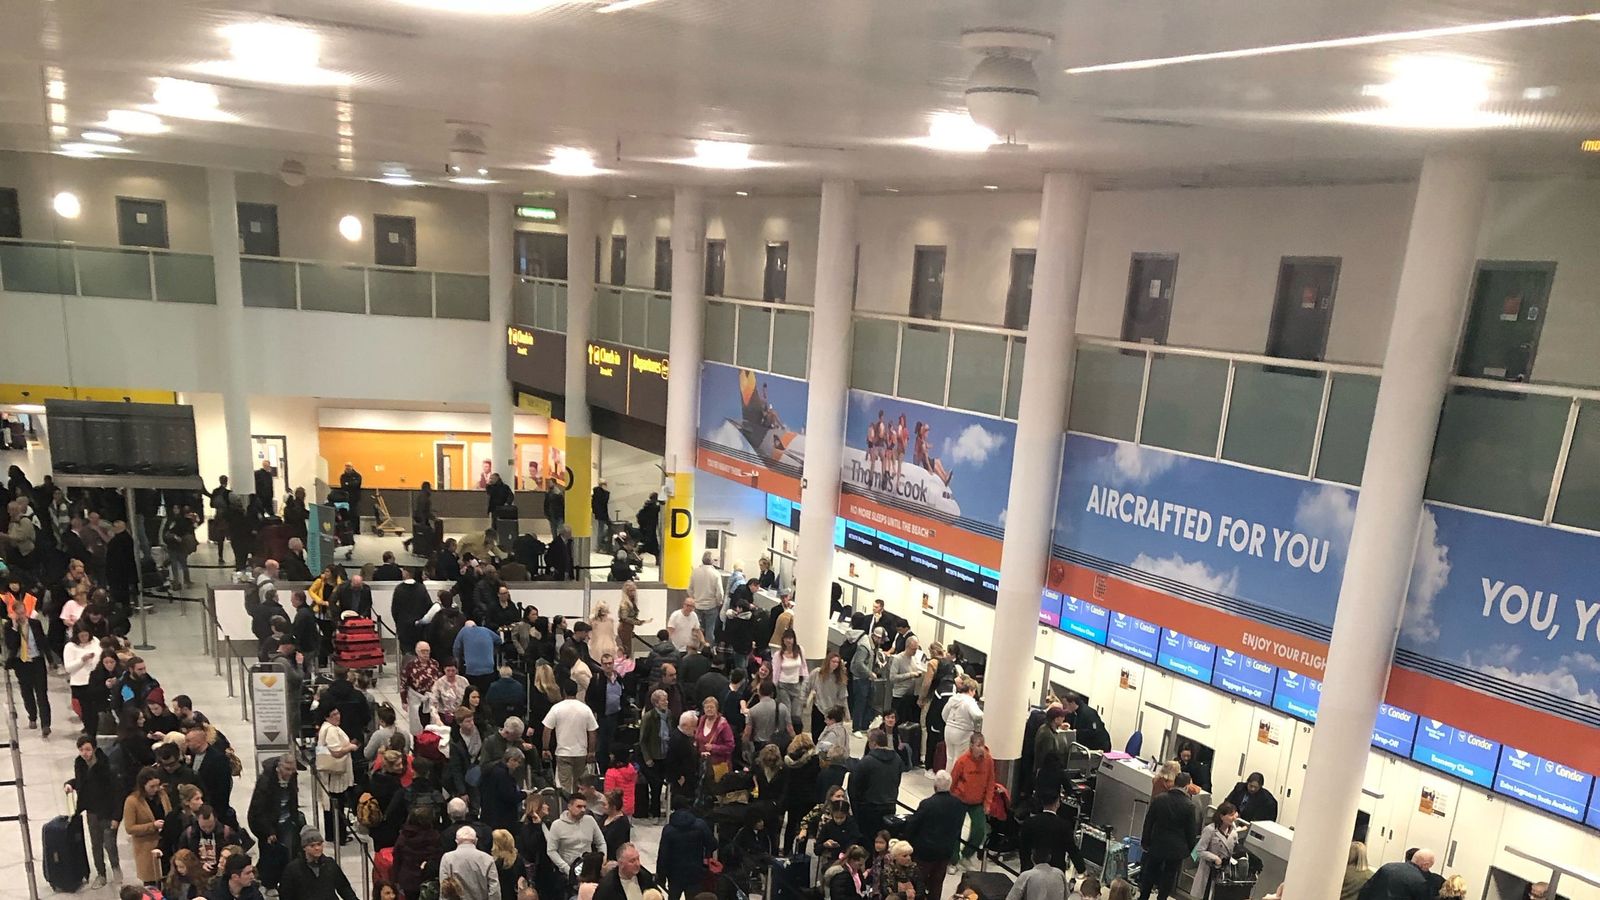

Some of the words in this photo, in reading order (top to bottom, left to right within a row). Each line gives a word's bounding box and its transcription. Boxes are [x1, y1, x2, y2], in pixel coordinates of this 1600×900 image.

[896, 473, 929, 503] Cook
[670, 508, 692, 539] D
[849, 504, 858, 515] NO
[858, 506, 872, 520] MORE
[871, 511, 887, 525] SLEEPS
[887, 516, 902, 530] UNTIL
[901, 520, 912, 533] THE
[911, 524, 930, 538] BEACH
[1085, 484, 1213, 543] AIRCRAFTED
[1217, 515, 1267, 558] FOR
[1272, 527, 1330, 574] YOU
[1090, 604, 1106, 617] Condor
[1481, 577, 1560, 641] YOU,
[1575, 599, 1600, 643] Y
[1139, 622, 1156, 634] Condor
[1193, 640, 1211, 653] Condor
[1241, 632, 1273, 652] ENJOY
[1272, 642, 1300, 662] YOUR
[1252, 660, 1272, 674] Condor
[1387, 707, 1411, 722] Condor
[1303, 726, 1311, 734] 93
[1374, 734, 1400, 748] Drop-Off
[1467, 734, 1493, 751] Condor
[1456, 763, 1474, 777] Class
[1555, 764, 1585, 783] Condor
[1551, 799, 1579, 815] Available
